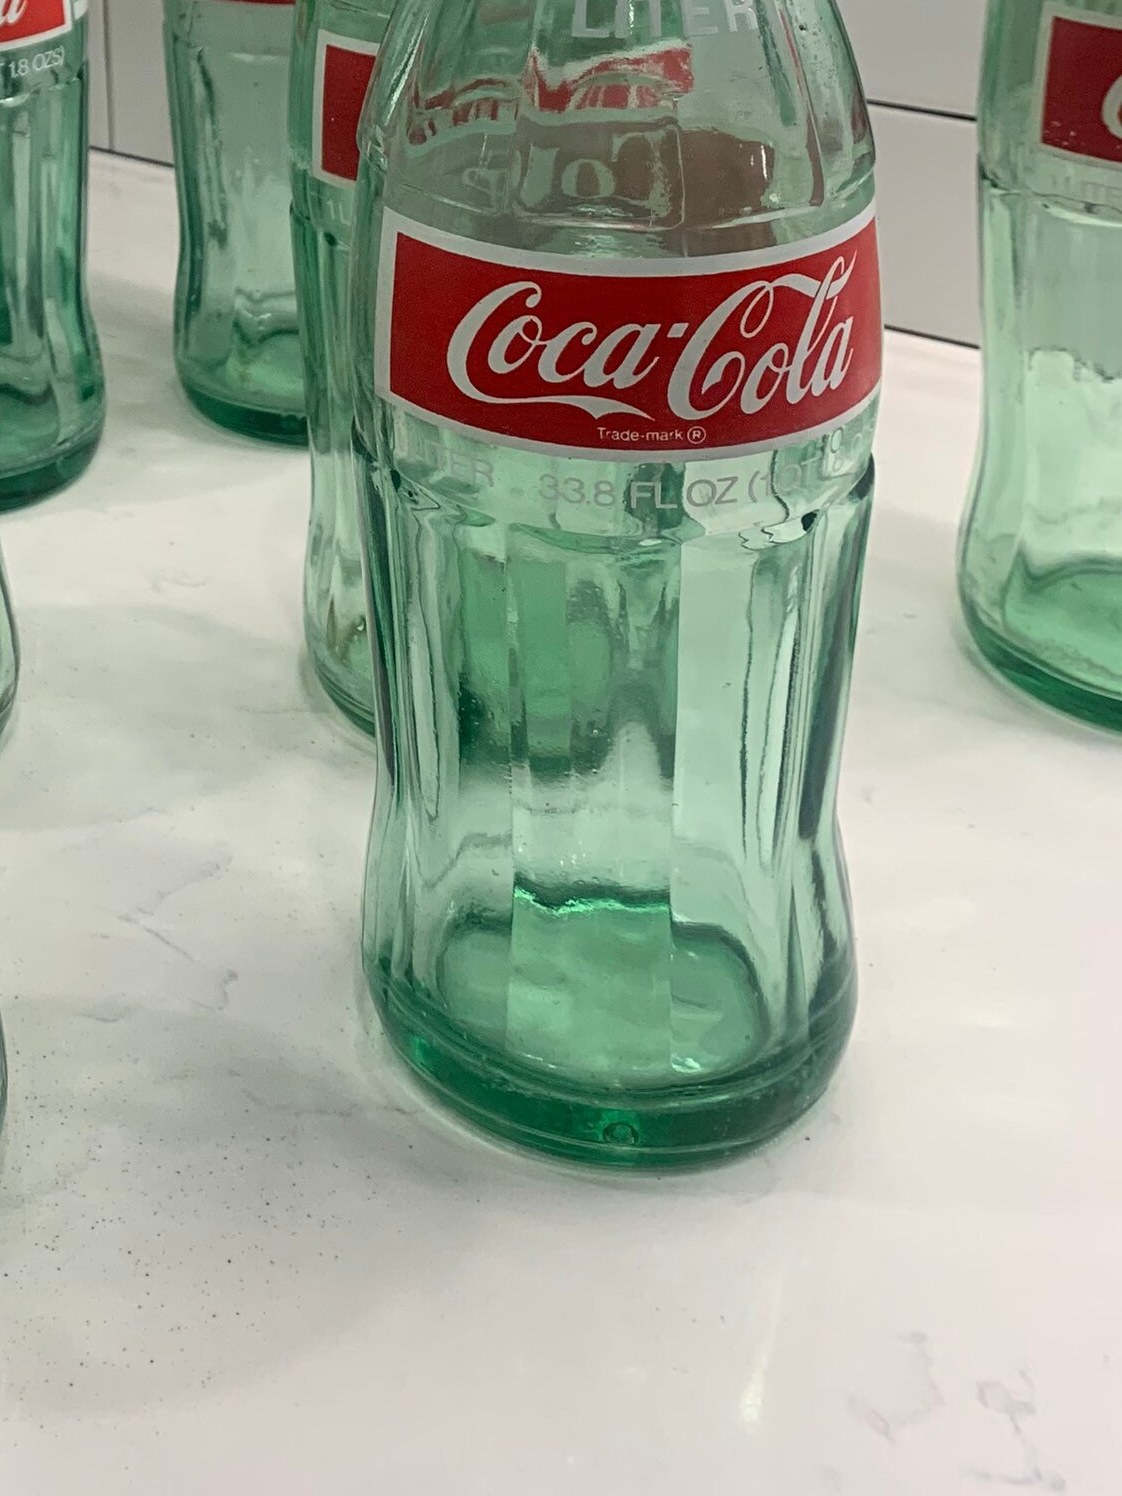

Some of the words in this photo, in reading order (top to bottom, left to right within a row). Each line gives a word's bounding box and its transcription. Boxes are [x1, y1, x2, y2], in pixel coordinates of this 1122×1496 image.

[446, 249, 858, 422] Coca-Cola
[597, 427, 684, 443] Trade-mark
[538, 473, 617, 507] 33.8
[630, 480, 678, 510] FL
[686, 475, 739, 508] OZ
